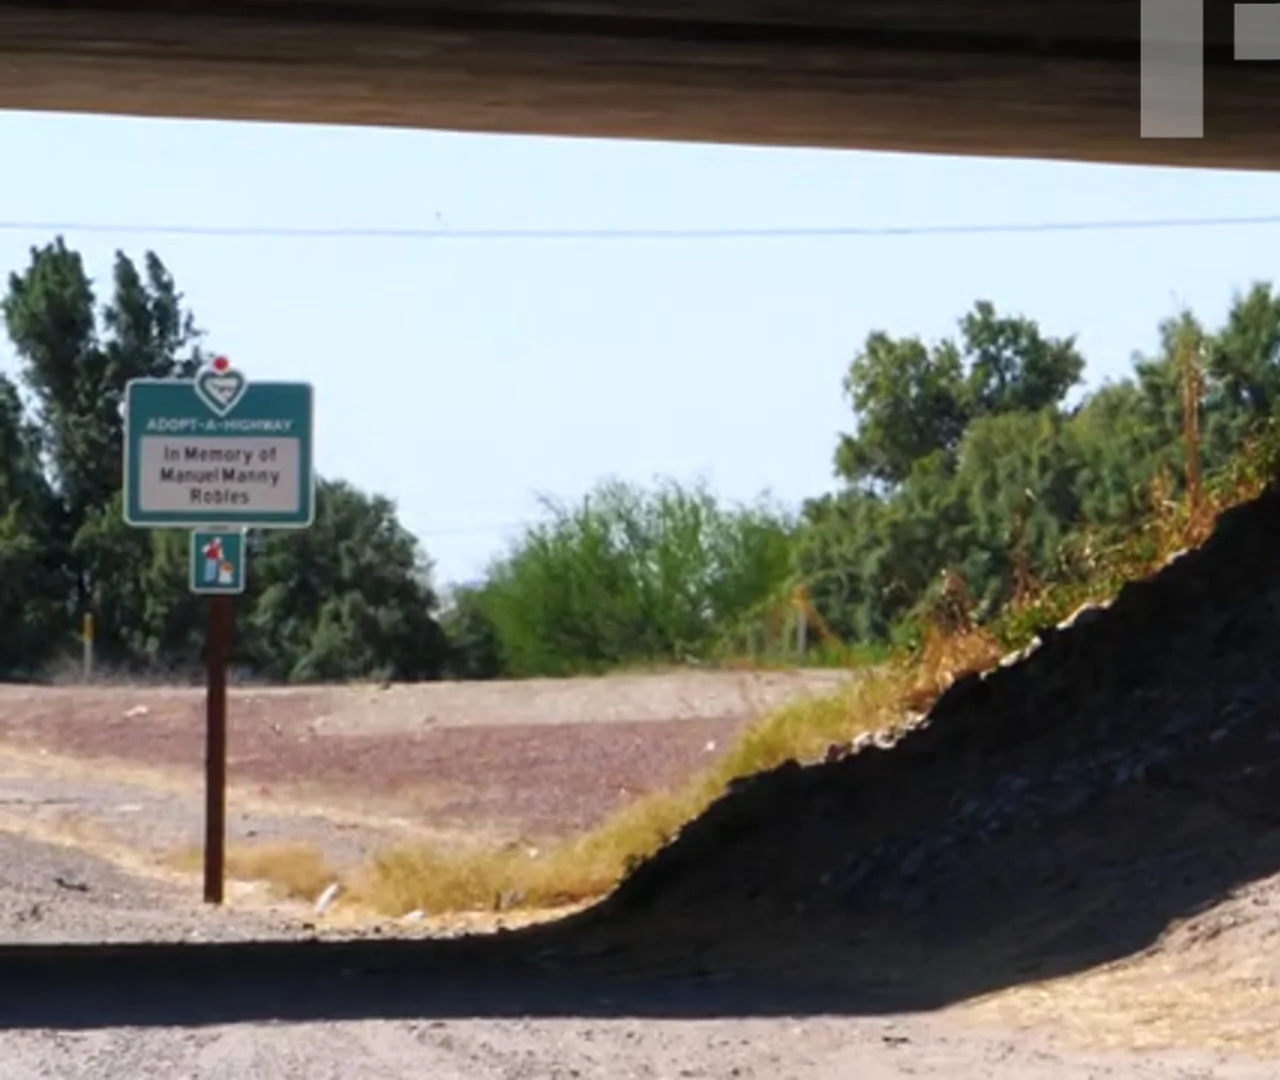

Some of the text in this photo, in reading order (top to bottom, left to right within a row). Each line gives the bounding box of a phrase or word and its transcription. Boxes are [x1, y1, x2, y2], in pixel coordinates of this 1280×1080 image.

[163, 446, 277, 466] In Memory of
[160, 467, 280, 488] Manuel Manny
[189, 487, 250, 505] Robles
